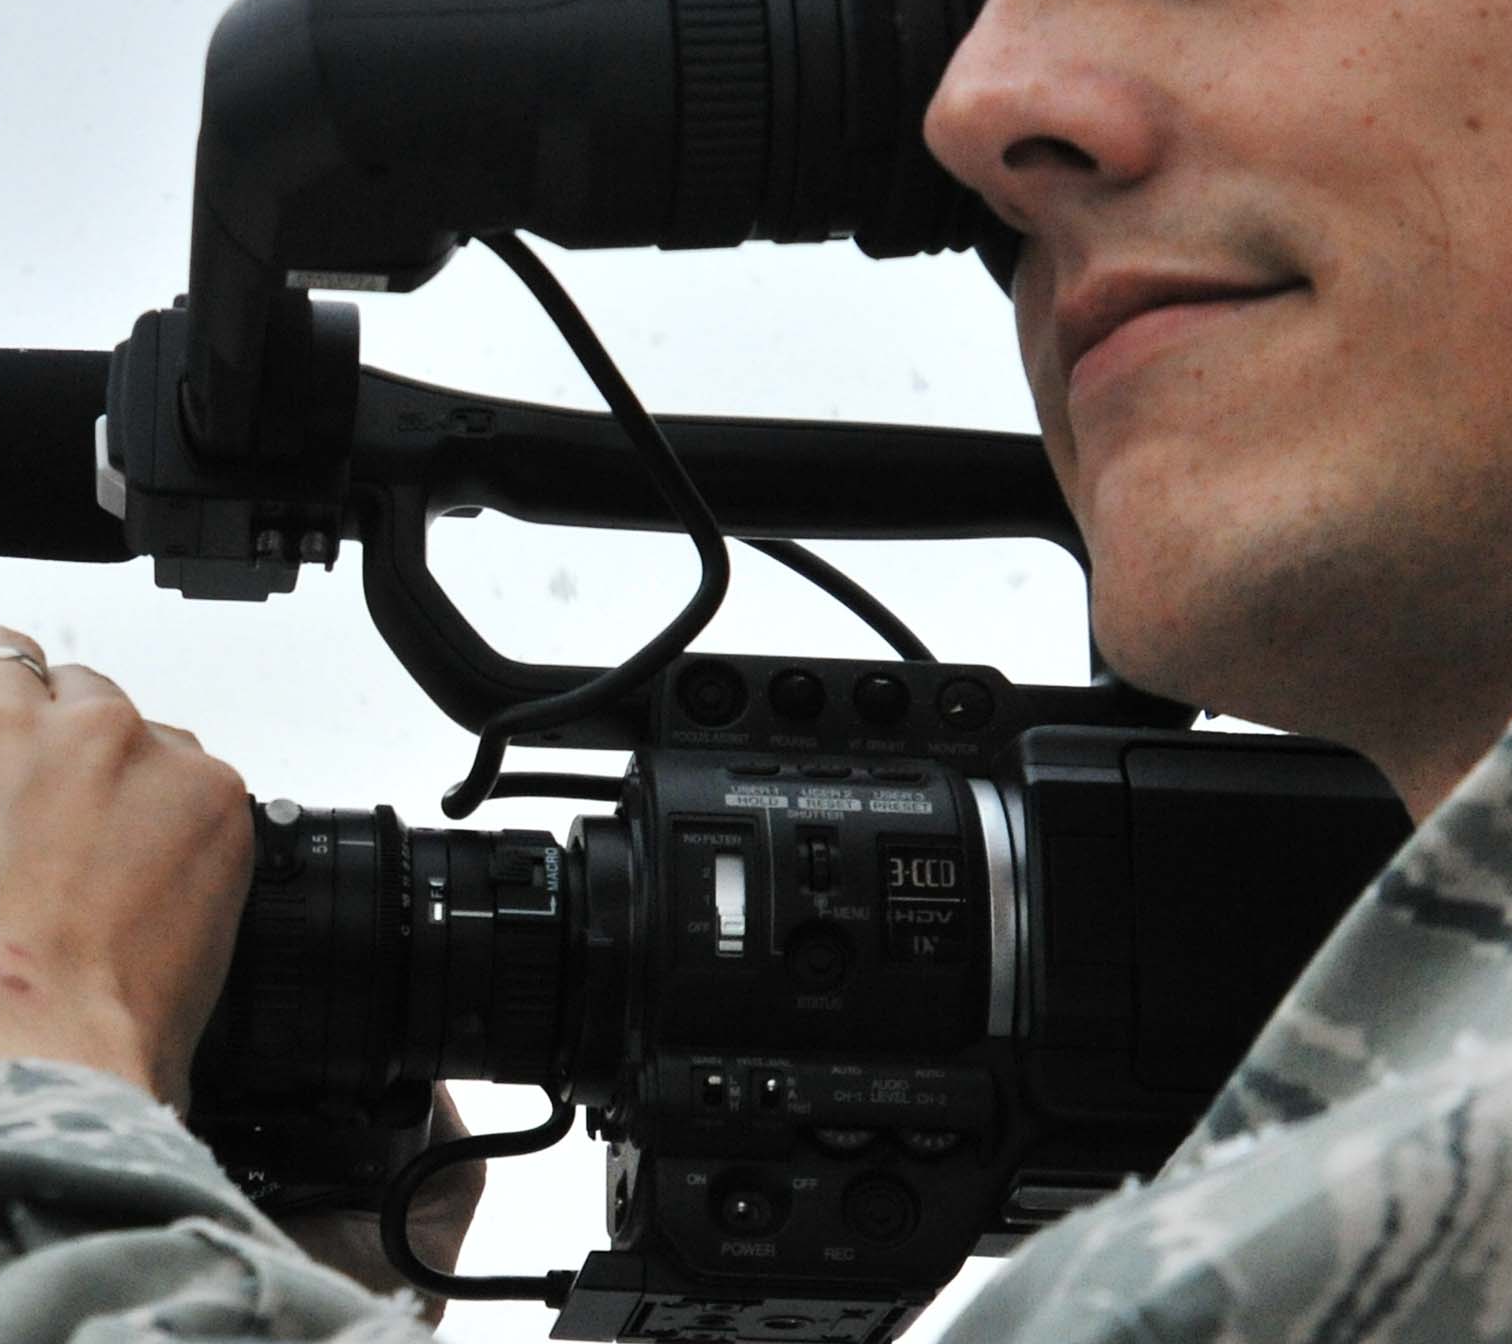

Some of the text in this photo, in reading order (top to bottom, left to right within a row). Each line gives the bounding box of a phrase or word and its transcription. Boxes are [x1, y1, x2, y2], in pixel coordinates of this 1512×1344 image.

[806, 799, 855, 810] RESET
[873, 802, 929, 813] PRESET
[787, 809, 845, 821] SHUTTER
[544, 846, 560, 892] MACRO
[870, 1090, 911, 1104] LEVEL
[685, 1173, 707, 1186] ON
[792, 1178, 819, 1190] OFF
[721, 1242, 776, 1257] POWER
[824, 1248, 856, 1261] REC
